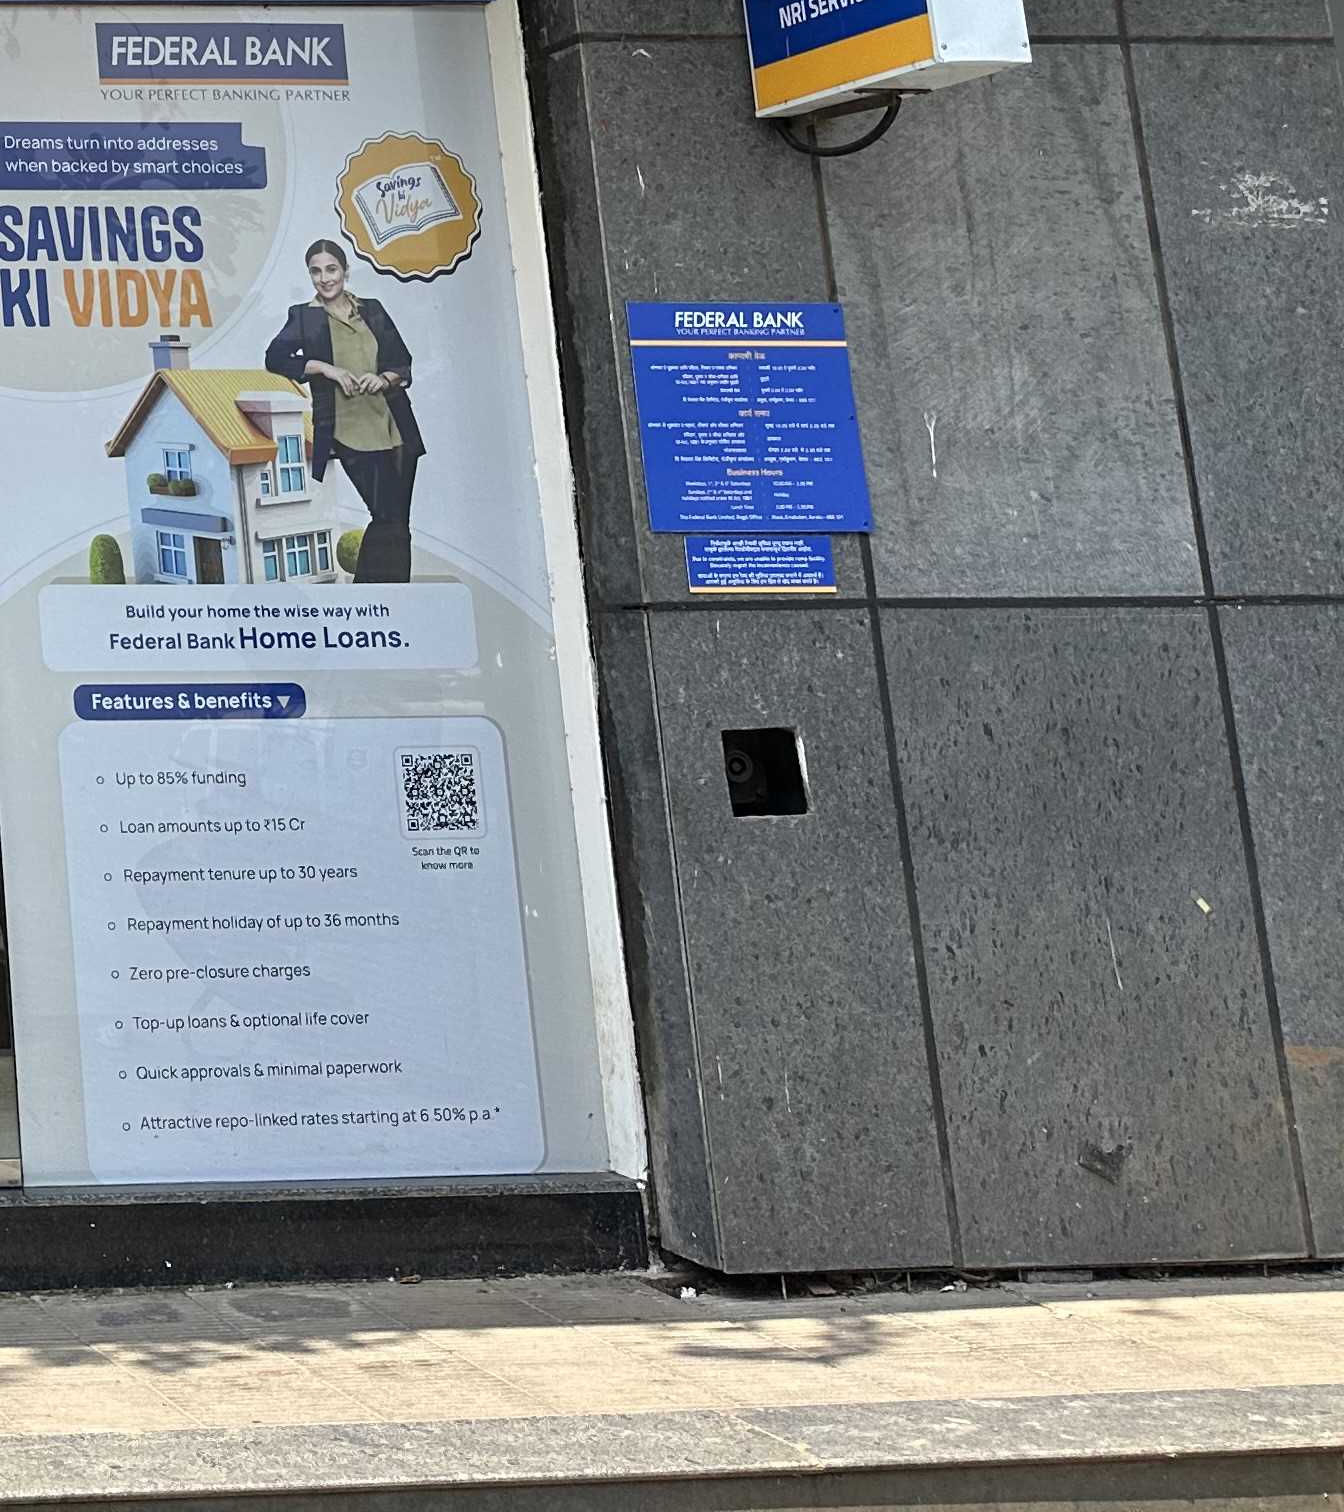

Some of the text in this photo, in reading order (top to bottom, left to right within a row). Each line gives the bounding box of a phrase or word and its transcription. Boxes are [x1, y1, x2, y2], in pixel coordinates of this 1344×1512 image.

[112, 36, 333, 67] FEDERAL BANK
[4, 134, 218, 151] Dreams turn into addresses
[5, 158, 243, 176] when backed by smart choices
[1, 268, 212, 328] KI VIDYA
[675, 312, 803, 328] FEDERAL BANK
[110, 626, 409, 650] Federal Bank Home Loans.
[91, 692, 272, 710] Features & benefits
[120, 817, 305, 835] Loan amounts up to ₹15 Cr
[130, 964, 310, 982] Zero pre-closure charges
